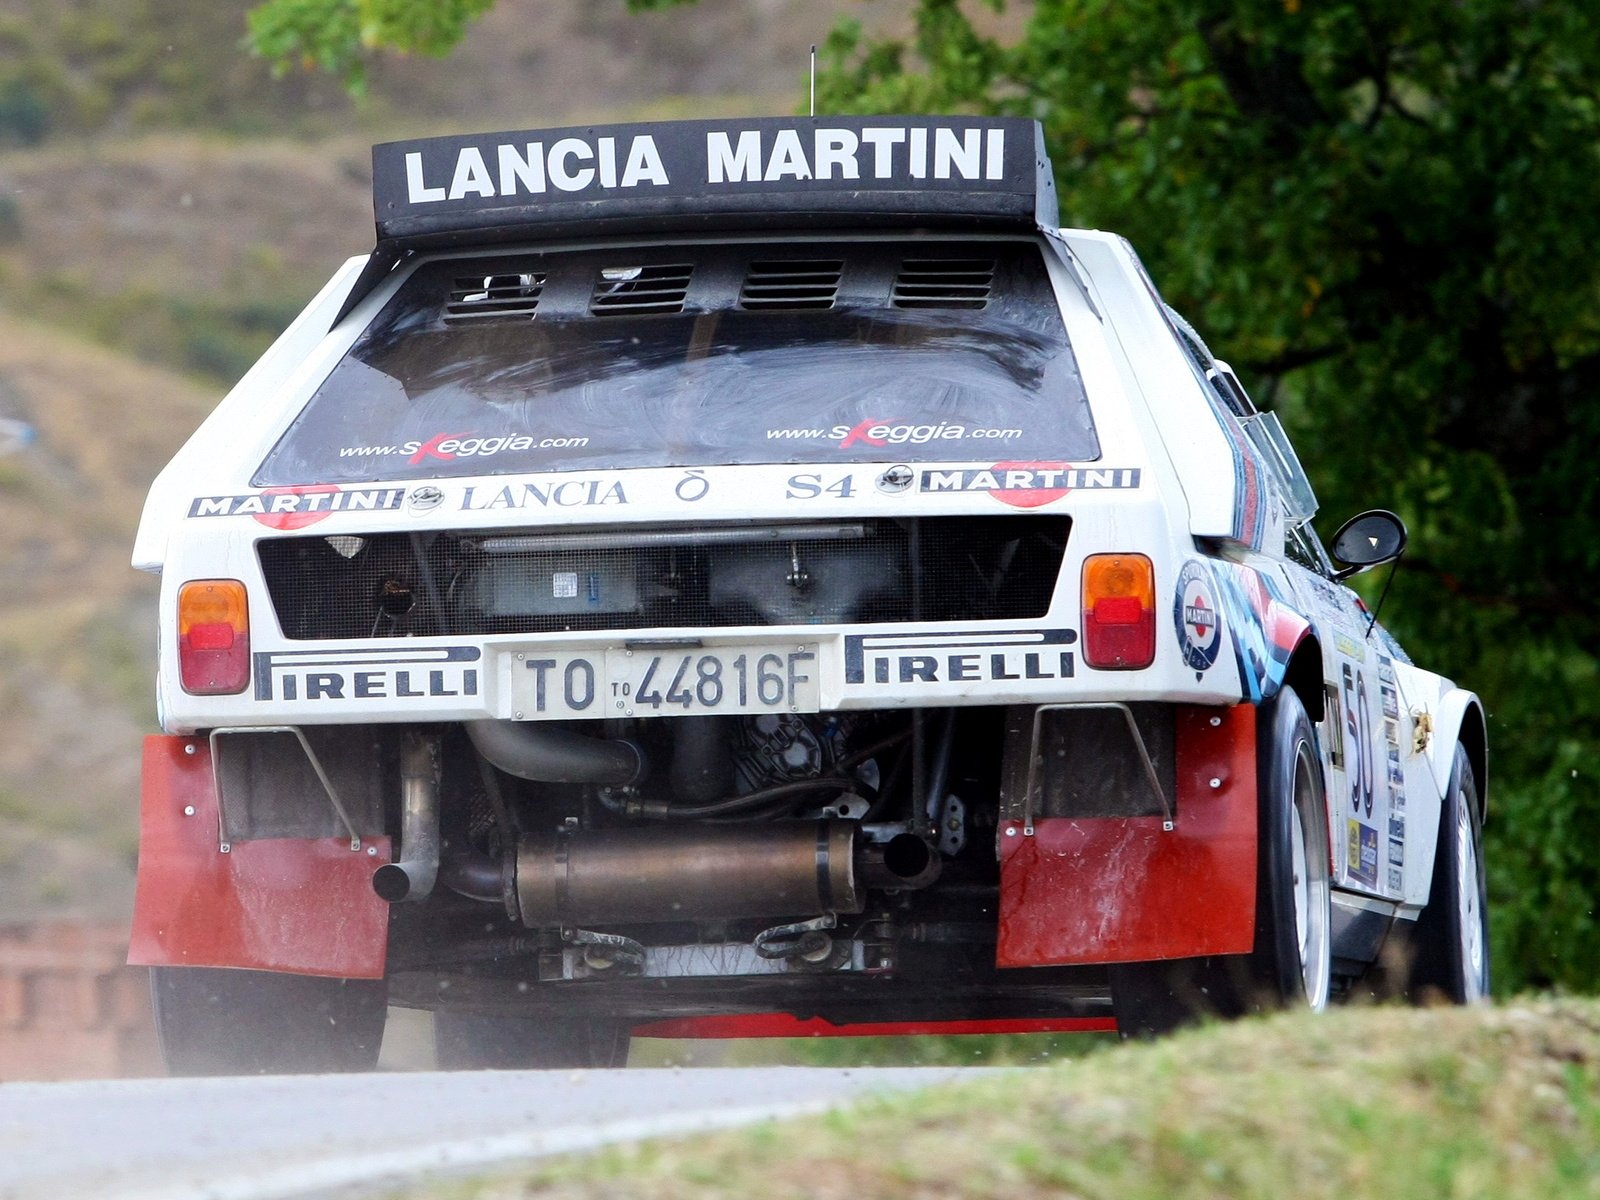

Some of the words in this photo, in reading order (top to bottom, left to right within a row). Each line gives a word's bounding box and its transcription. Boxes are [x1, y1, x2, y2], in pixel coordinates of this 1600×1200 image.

[404, 134, 670, 205] LANCIA
[706, 127, 1006, 185] MARTINI
[193, 488, 402, 517] MARTINI
[457, 480, 629, 511] LANCIA
[785, 474, 858, 500] S4
[926, 467, 1136, 491] MARTINI
[1187, 606, 1214, 626] MARTINI
[253, 646, 482, 702] PIRELLI
[526, 658, 595, 712] TO
[635, 652, 816, 709] 44816F
[845, 628, 1078, 684] PIRELLI
[1341, 662, 1374, 819] 50
